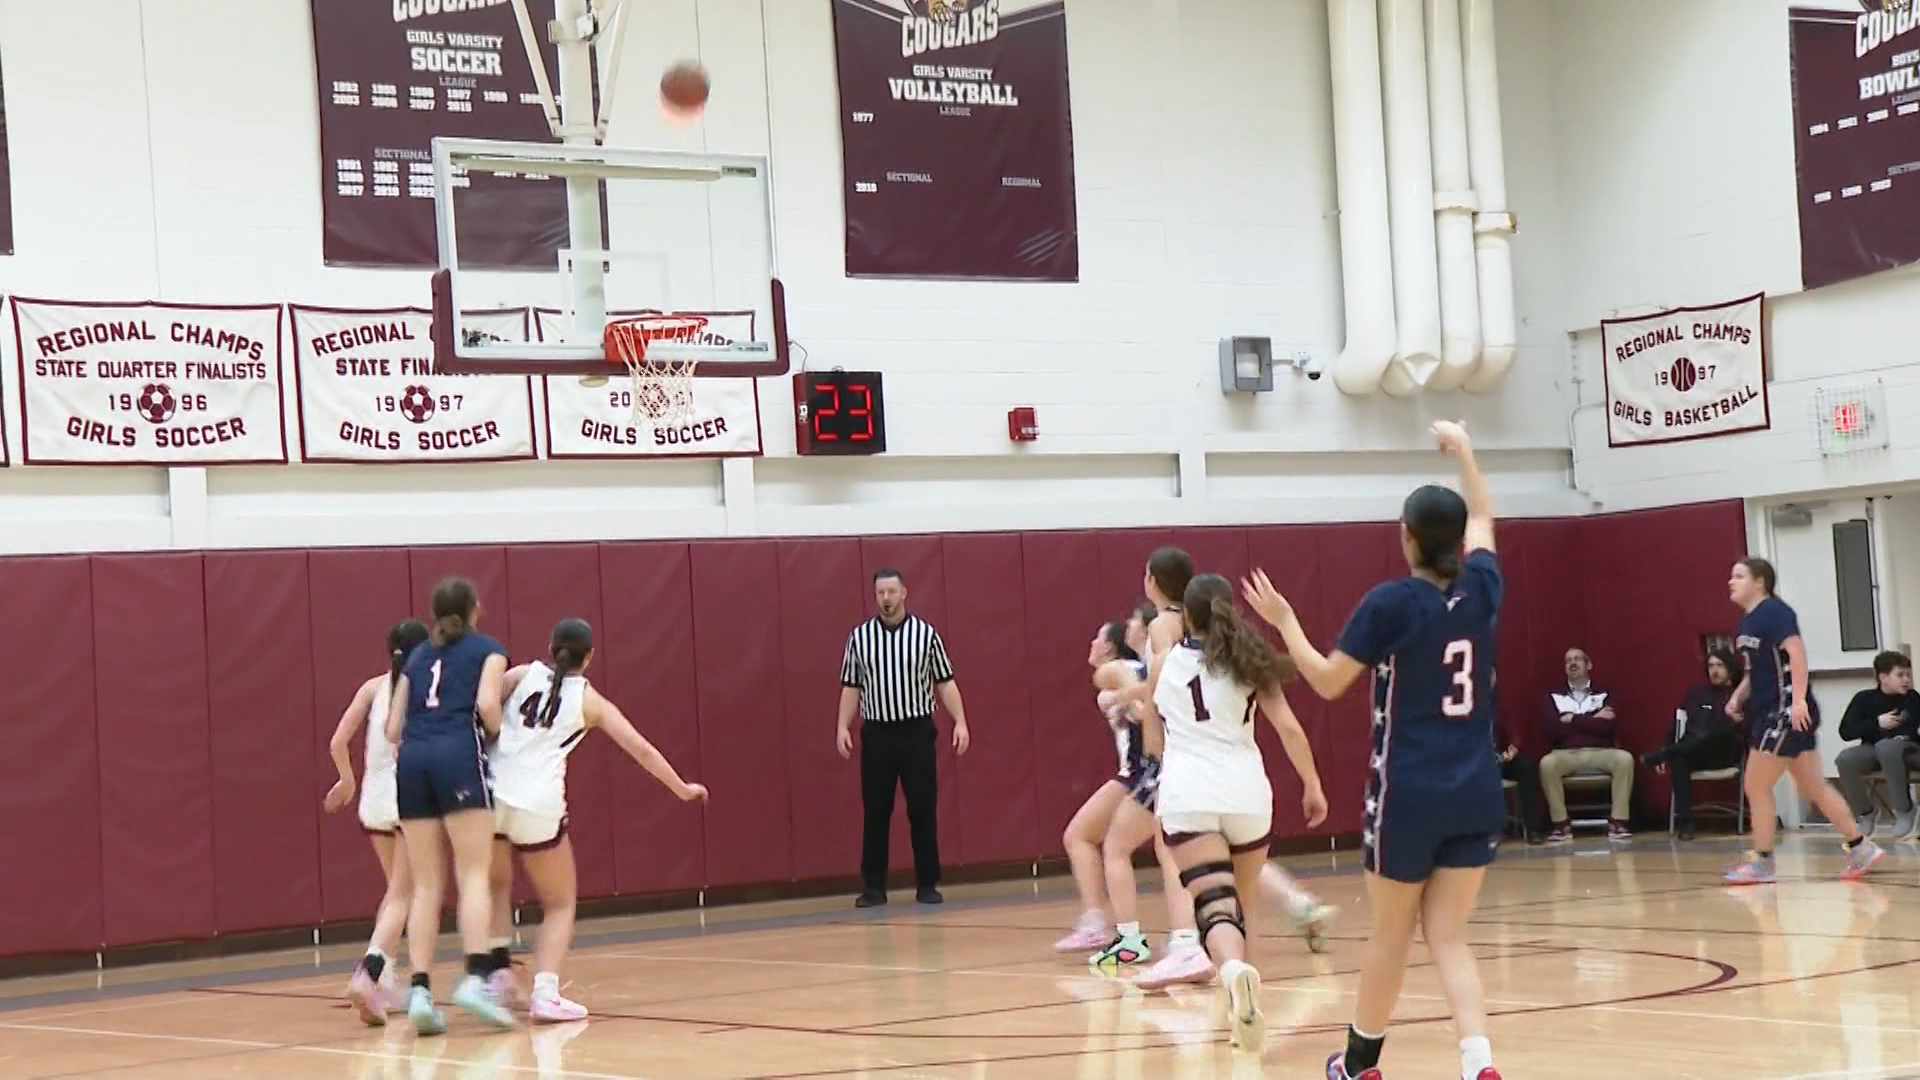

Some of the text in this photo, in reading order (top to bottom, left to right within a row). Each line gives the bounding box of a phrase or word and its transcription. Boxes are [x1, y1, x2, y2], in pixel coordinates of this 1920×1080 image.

[406, 29, 504, 49] GIRLS VARSITY
[902, 3, 999, 57] COUGARS
[410, 47, 503, 75] SOCCER
[913, 64, 994, 81] GIRLS VARSITY
[1891, 49, 1919, 67] BOYS
[438, 76, 477, 88] LEAGUE
[888, 77, 1018, 107] VOLLEYBALL
[1859, 63, 1920, 100] BOWL
[939, 105, 971, 116] LEAGUE
[374, 148, 431, 161] SECTIONAL
[886, 171, 933, 183] SECTIONAL
[36, 321, 264, 361] REGIONAL CHAMPS
[311, 321, 415, 357] REGIONAL
[1615, 323, 1752, 363] REGIONAL CHAMPS
[35, 358, 267, 381] STATE QUARTER FINALISTS
[335, 358, 391, 377] STATE
[108, 393, 208, 411] 19 96
[376, 395, 396, 412] 19
[610, 391, 631, 408] 20
[814, 384, 874, 441] 23
[1613, 384, 1758, 428] GIRLS BASKETBALL
[66, 416, 247, 448] GIRLS SOCCER
[338, 420, 501, 452] GIRLS SOCCER
[580, 416, 728, 445] GIRLS SOCCER
[425, 658, 442, 709] 1
[1441, 638, 1474, 717] 3
[1186, 673, 1211, 722] 1
